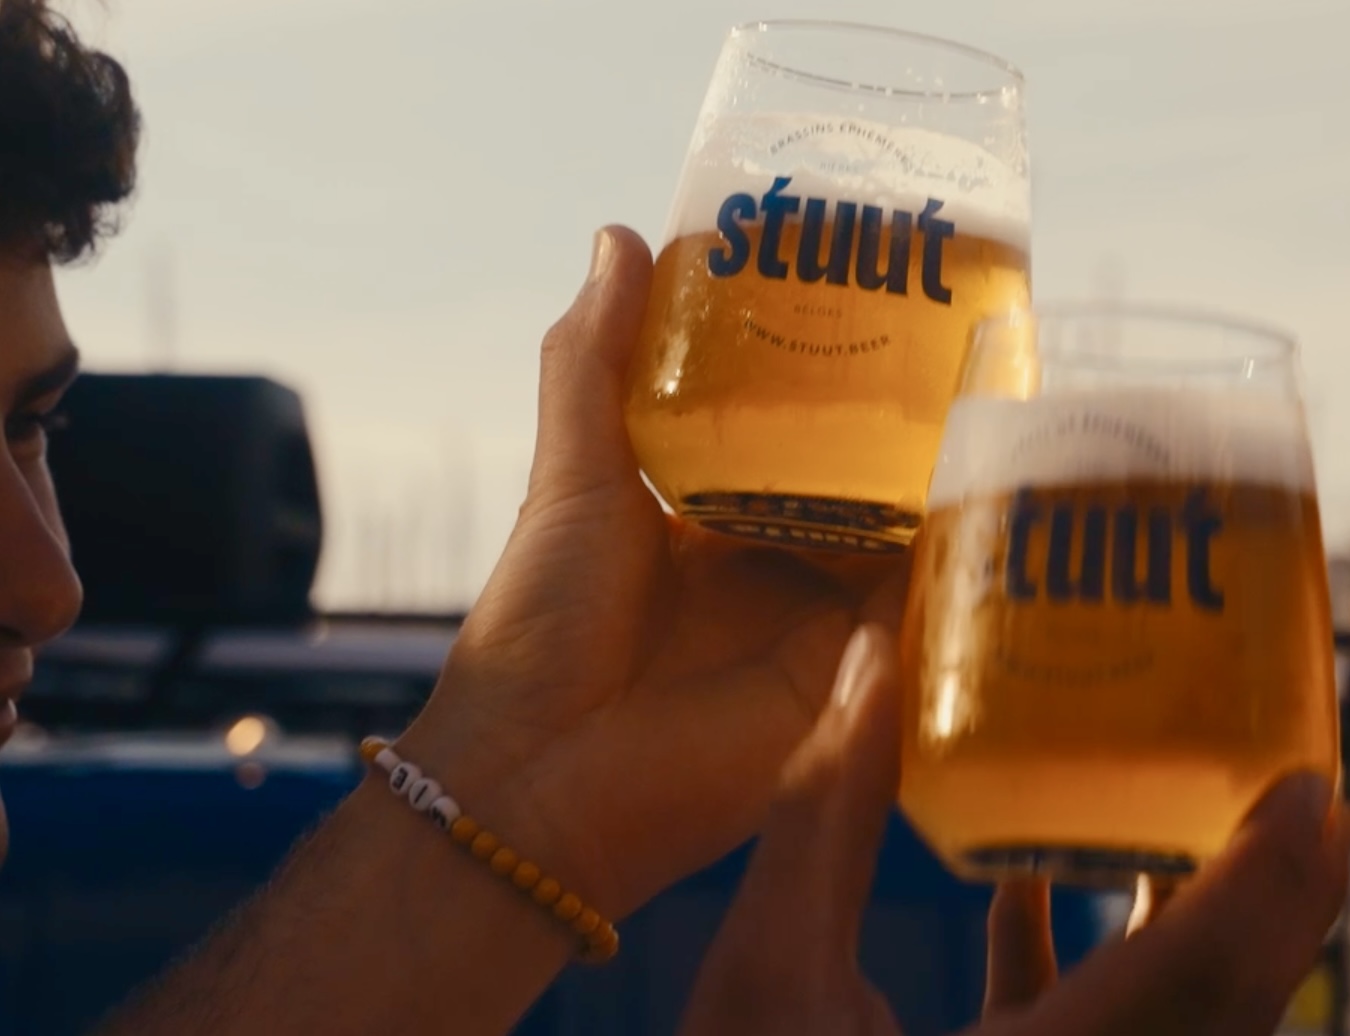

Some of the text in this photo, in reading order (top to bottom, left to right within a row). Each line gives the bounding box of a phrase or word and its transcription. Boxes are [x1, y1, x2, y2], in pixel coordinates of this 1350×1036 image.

[770, 123, 833, 155] BRASSINS
[743, 318, 891, 357] WWW.STUUT.BEER
[1006, 484, 1225, 614] tuut
